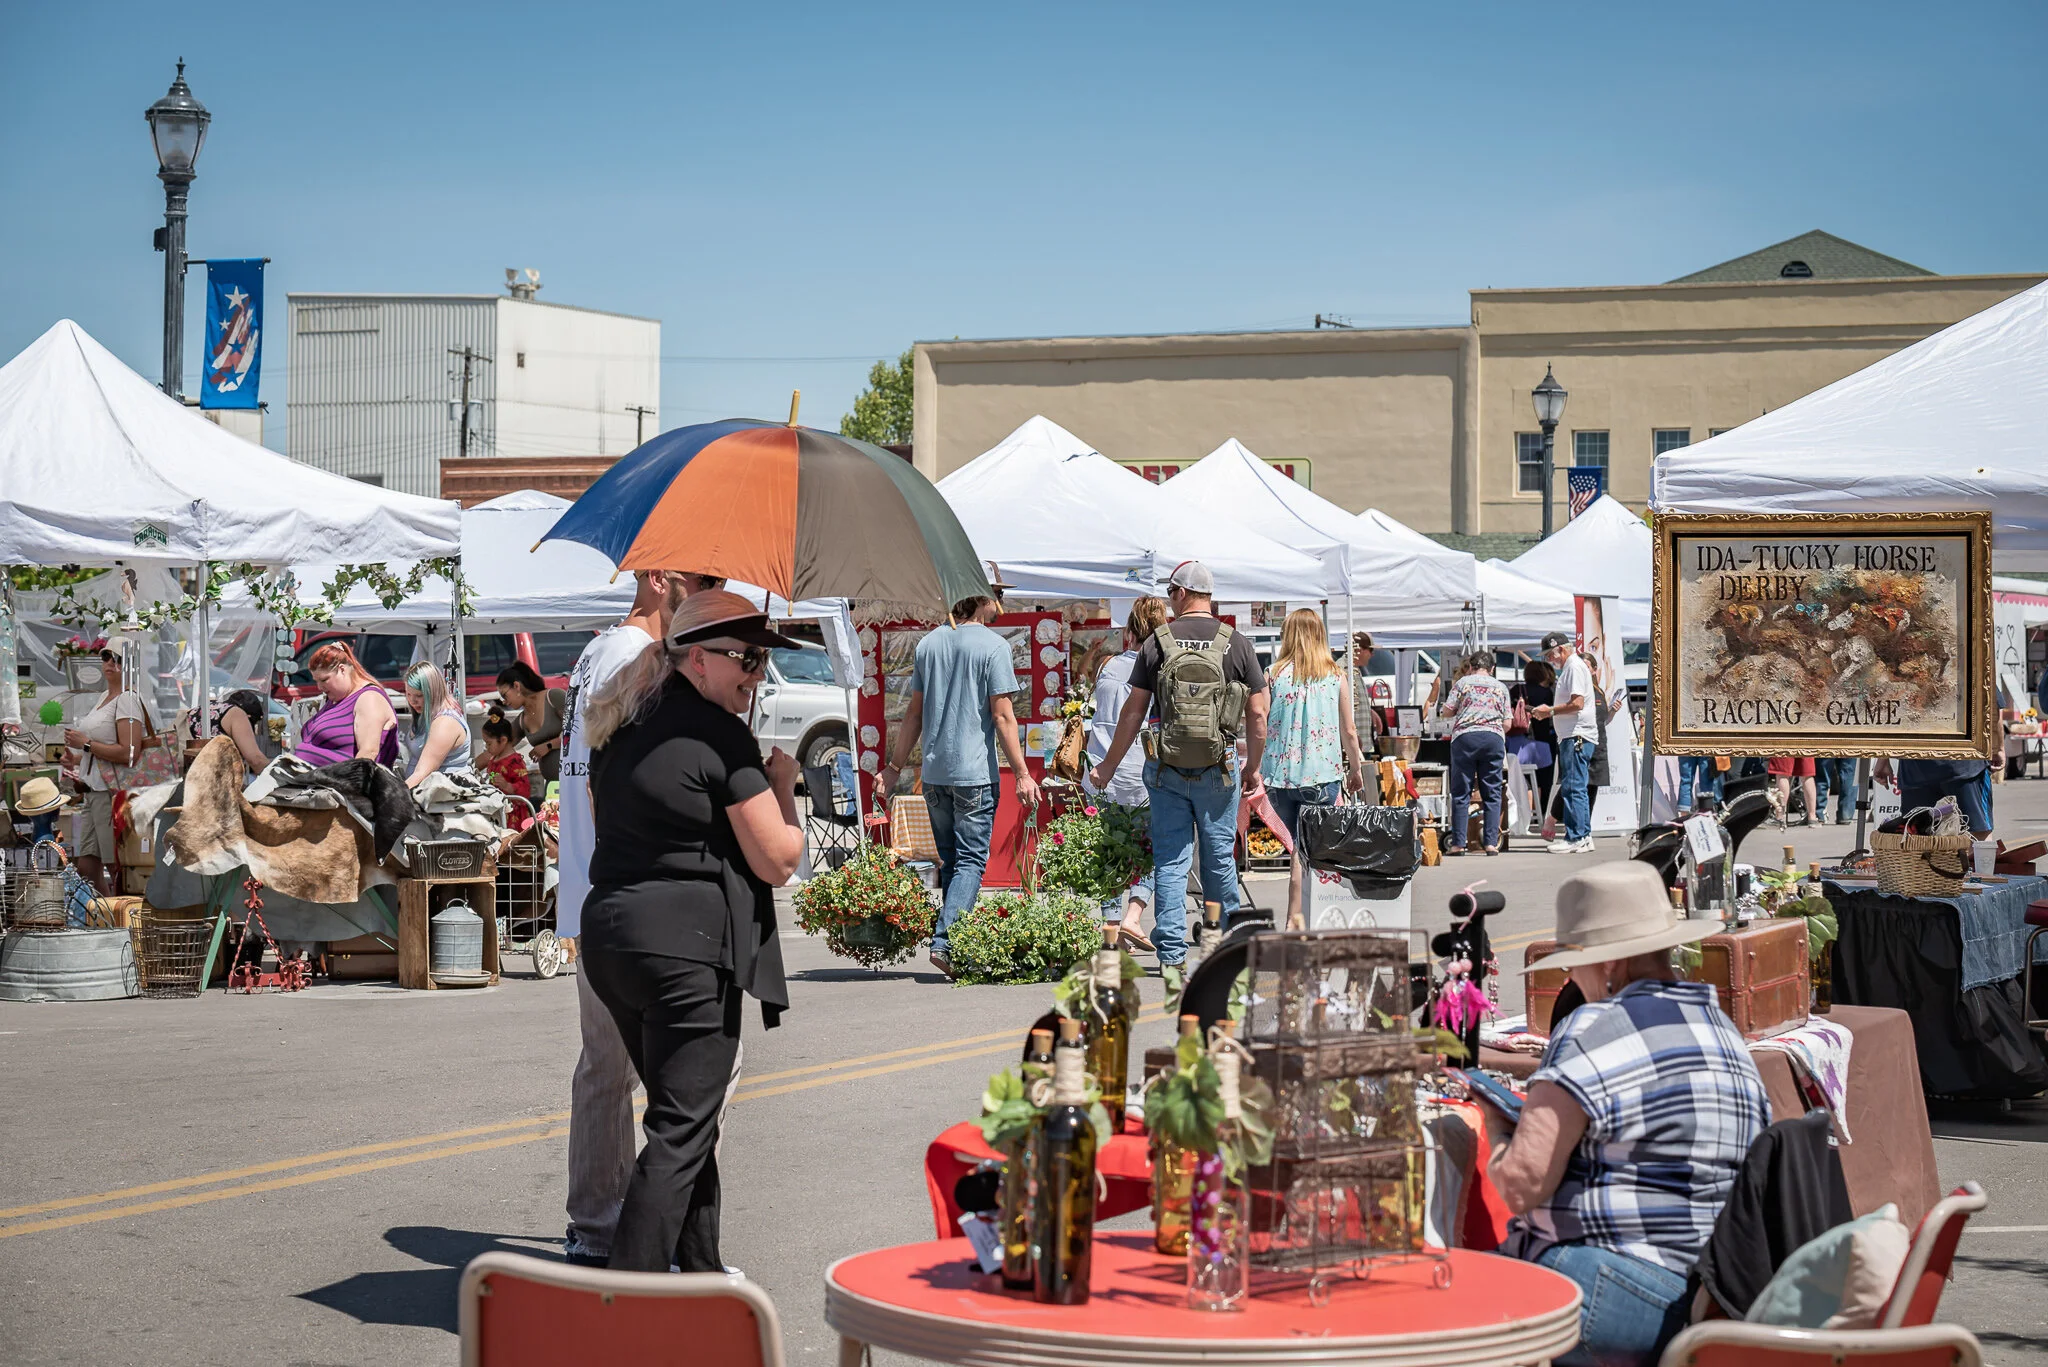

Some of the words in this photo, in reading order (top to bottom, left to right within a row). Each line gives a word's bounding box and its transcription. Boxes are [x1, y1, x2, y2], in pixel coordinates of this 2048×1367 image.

[134, 526, 167, 545] CARAVAN
[1697, 544, 1840, 571] IDA-TUCKY
[1854, 545, 1936, 572] HORSE
[1718, 575, 1807, 601] DERBY
[1702, 698, 1802, 725] RACING
[1826, 700, 1901, 726] GAME
[440, 856, 470, 866] FLOWERS
